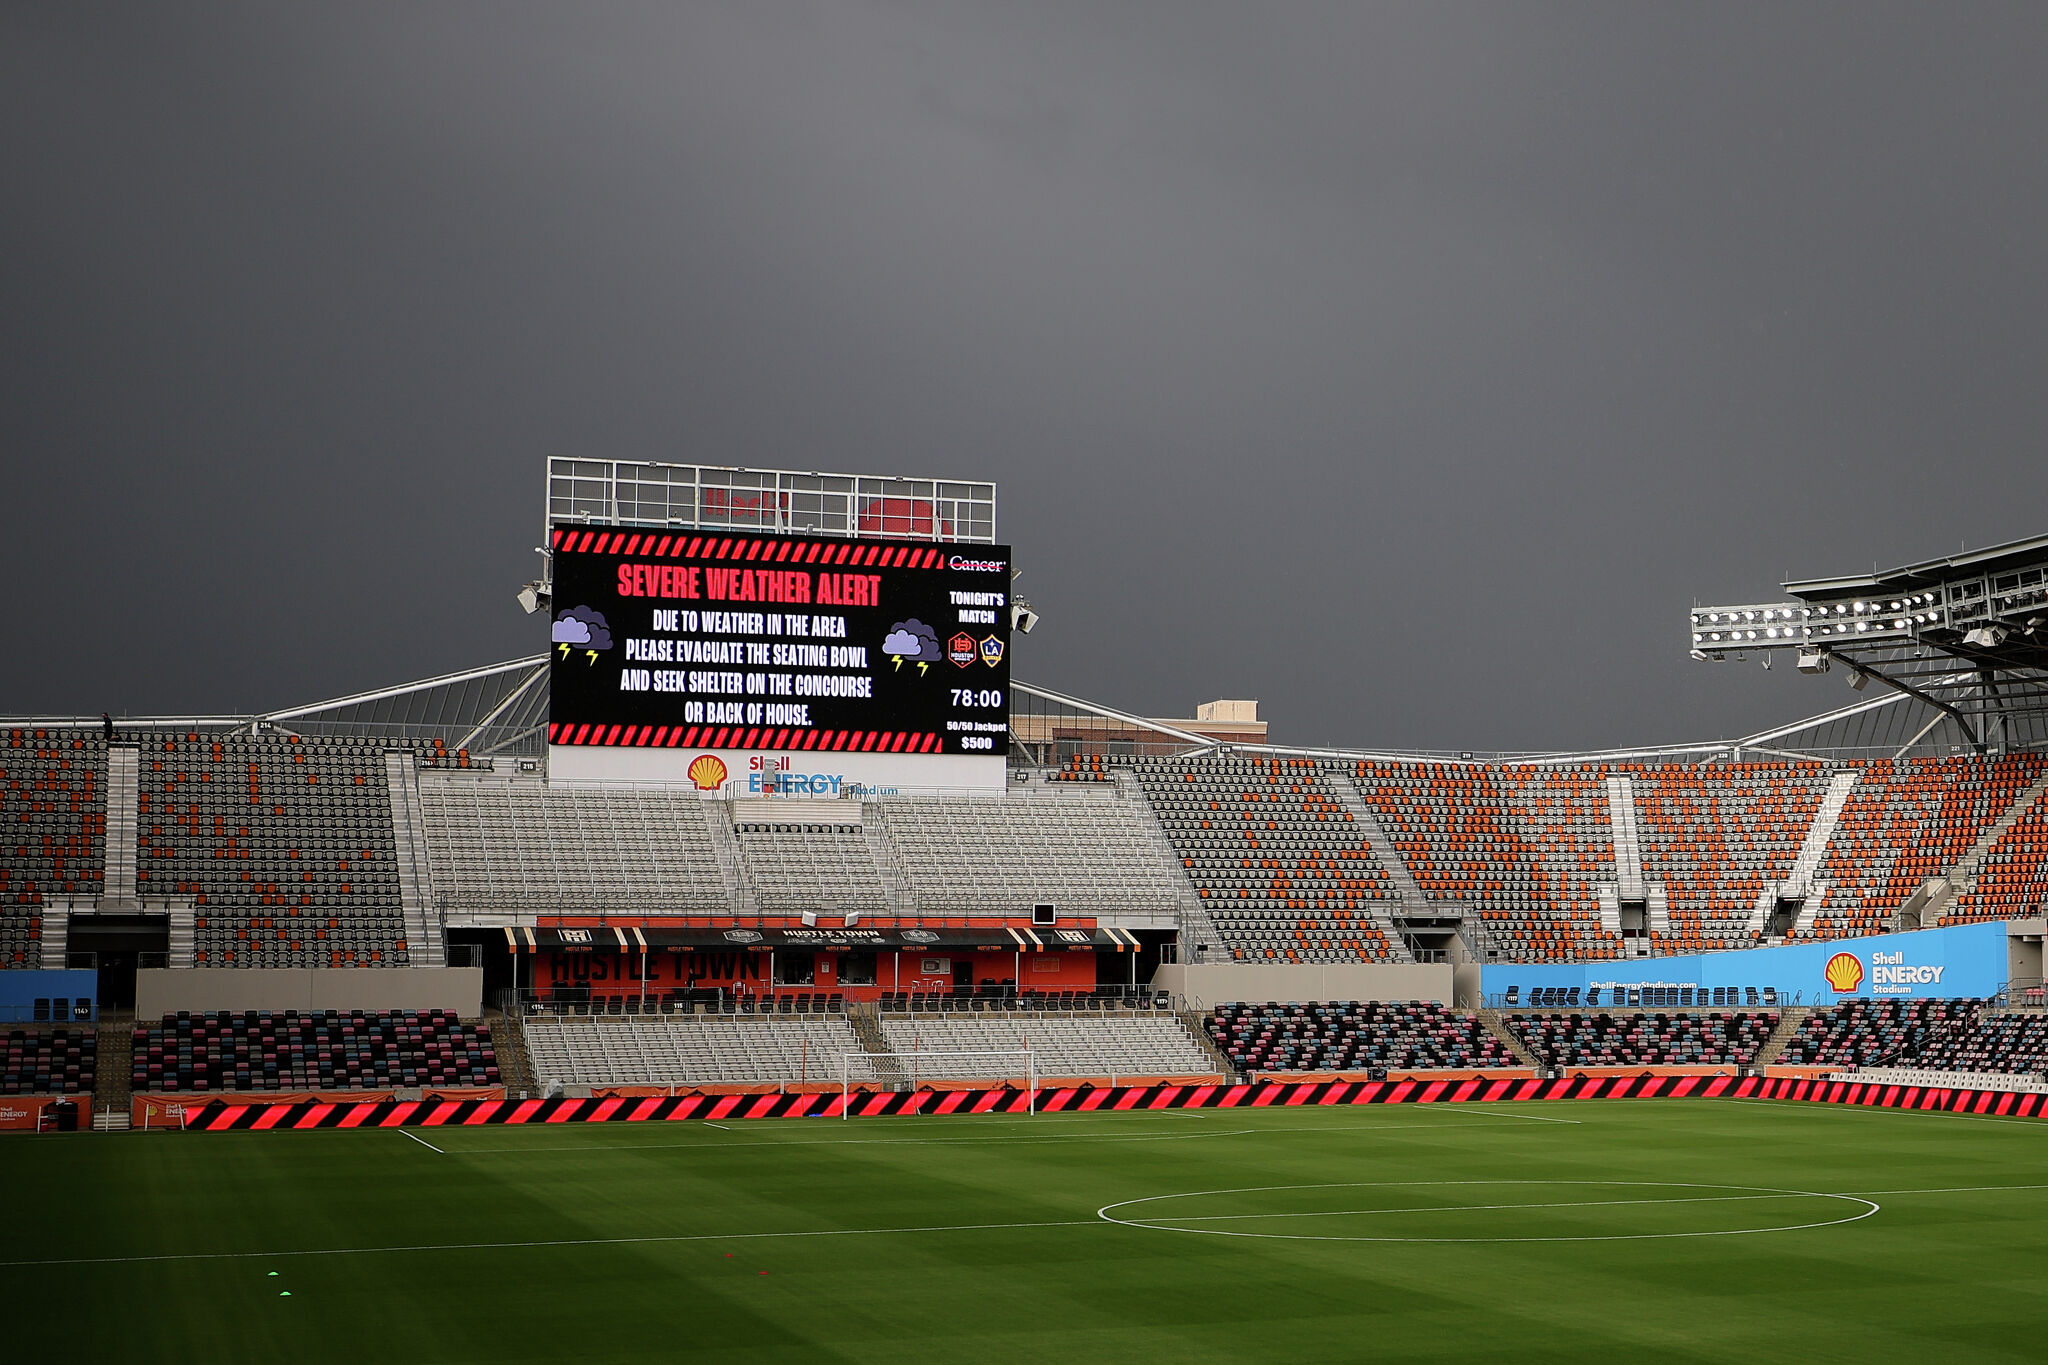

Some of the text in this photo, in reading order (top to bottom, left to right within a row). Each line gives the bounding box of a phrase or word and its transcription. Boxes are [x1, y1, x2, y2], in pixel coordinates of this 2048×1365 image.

[949, 555, 1003, 572] Cancer
[618, 564, 881, 606] SEVERE WEATHER ALERT
[949, 591, 1004, 606] TONIGHT'S
[653, 609, 845, 637] DUE TO WEATHER IN THE AREA
[958, 609, 995, 624] MATCH
[626, 639, 867, 667] PLEASE EVACUATE THE SEATING BOWL
[985, 646, 999, 656] LA
[620, 669, 871, 697] AND SEEK SHELTER ON THE CONCOURSE
[951, 689, 1001, 707] 78:00
[685, 701, 812, 725] OR BACK OF HOUSE.
[946, 721, 1007, 732] 50/50 Jackpot
[961, 736, 993, 749] $500
[848, 784, 898, 795] Stadum
[783, 930, 880, 938] HUSTLE TOWN
[551, 952, 760, 980] HUSTLE TOWN
[1872, 951, 1903, 965] Shell
[1872, 966, 1944, 984] ENERGY
[1873, 984, 1912, 994] Stadium
